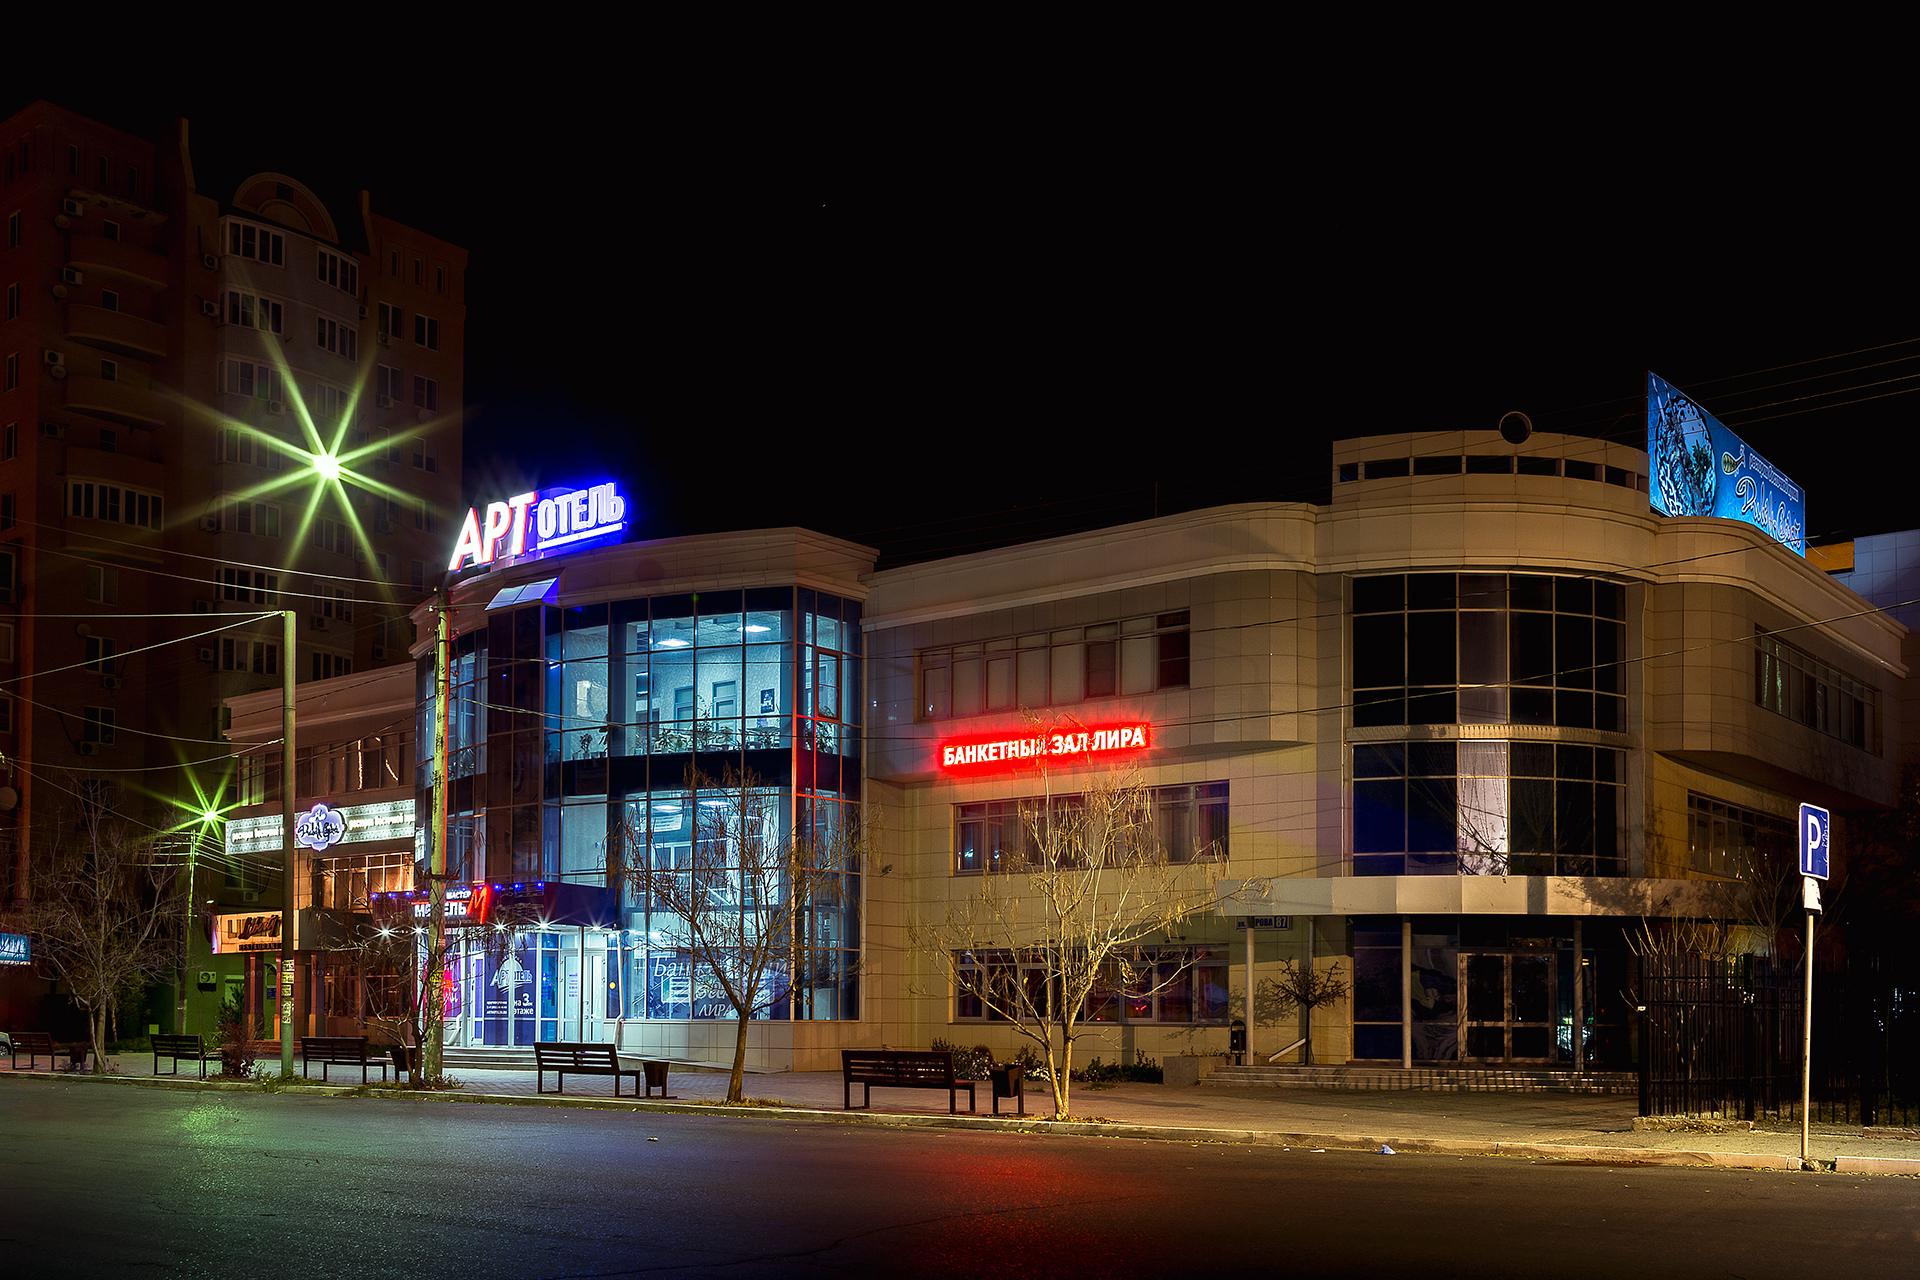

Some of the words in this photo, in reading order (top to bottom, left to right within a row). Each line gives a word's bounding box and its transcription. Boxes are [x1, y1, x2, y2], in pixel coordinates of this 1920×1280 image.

[448, 491, 537, 571] АРТ
[536, 482, 626, 538] ОТЕЛЬ
[943, 736, 1047, 767] БАНКЕТНЫЙ
[1050, 732, 1088, 755] ЗАЛ
[1091, 726, 1147, 751] ЛИРА
[1806, 813, 1822, 872] P
[414, 902, 467, 917] МЕЕЛЬ
